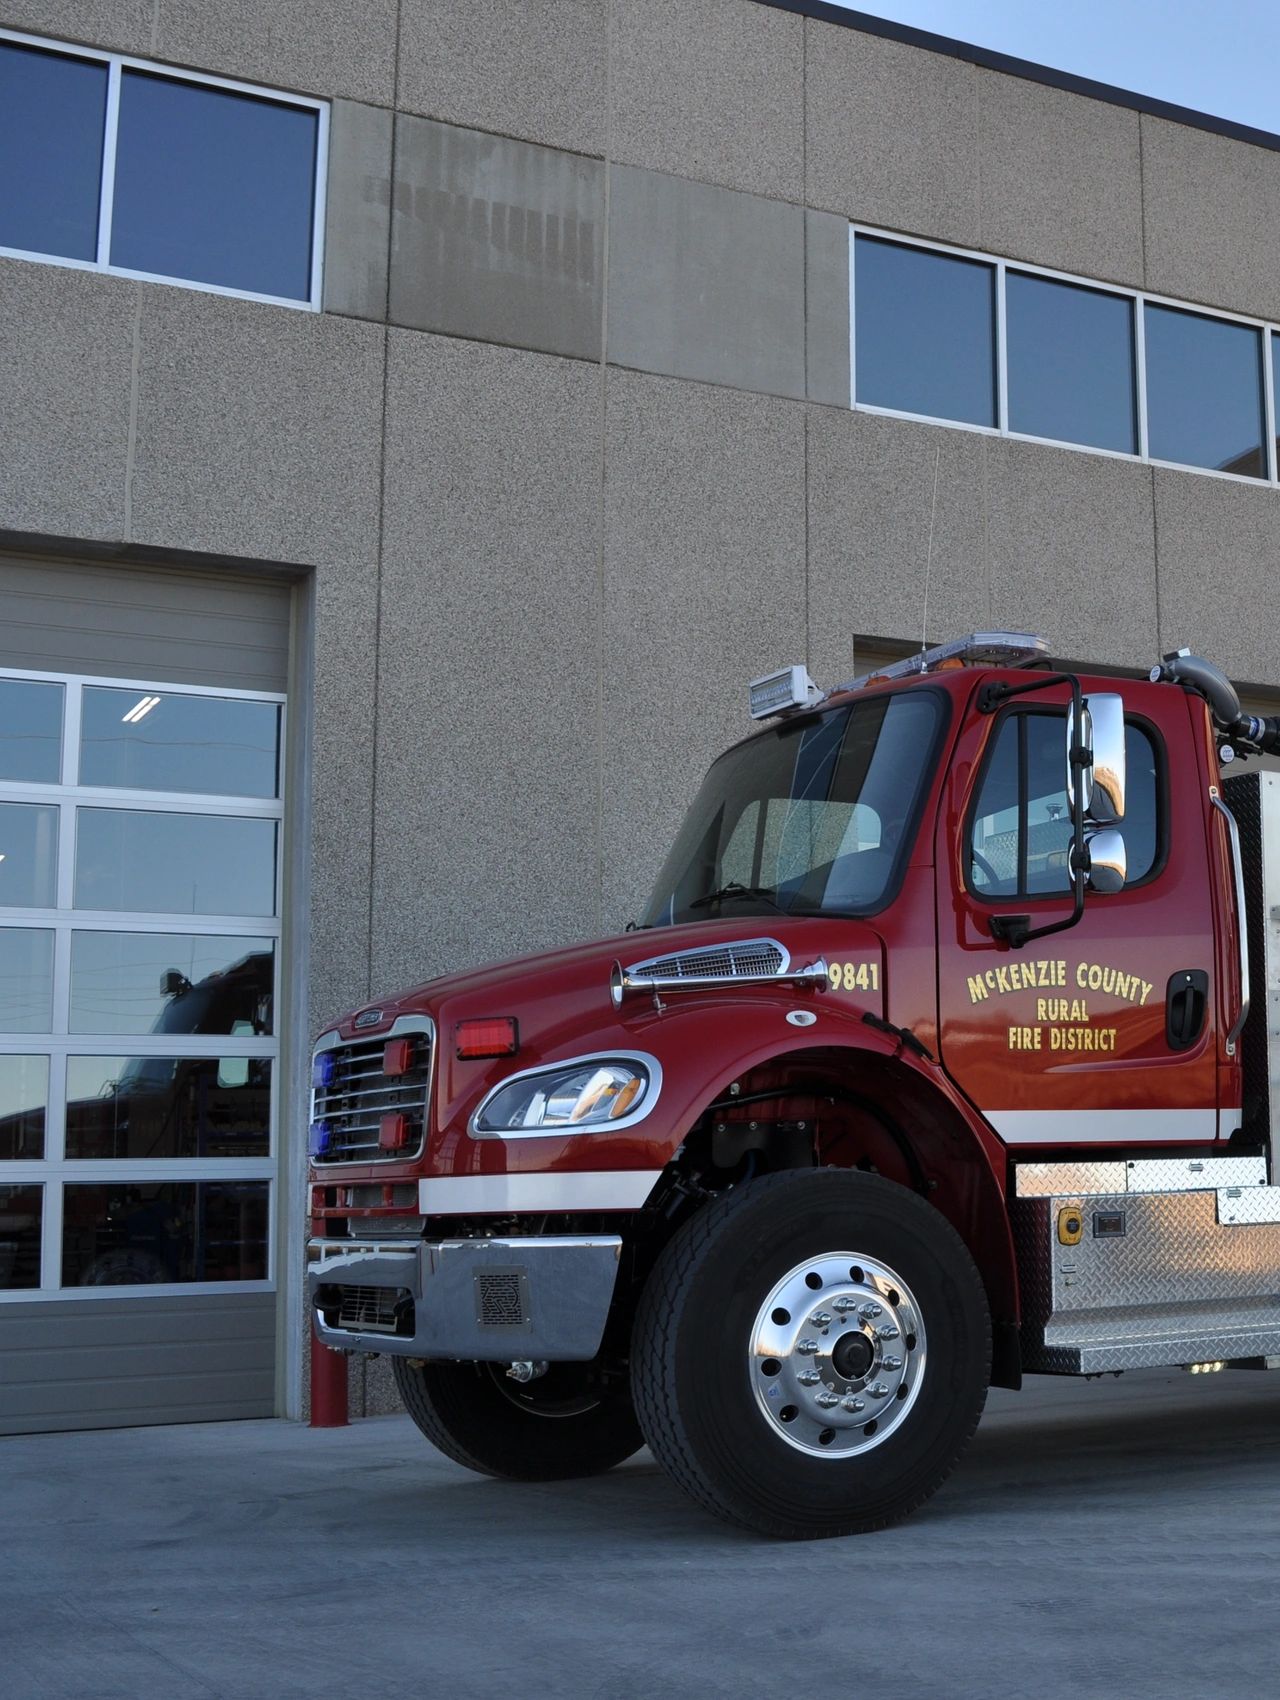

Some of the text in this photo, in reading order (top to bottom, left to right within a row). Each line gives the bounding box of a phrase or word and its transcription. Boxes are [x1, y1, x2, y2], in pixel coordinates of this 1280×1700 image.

[828, 962, 879, 991] 9841
[1076, 962, 1153, 1006] COUNTY
[1037, 998, 1090, 1022] RURAL
[1008, 1027, 1117, 1051] FIRE DISTRICT
